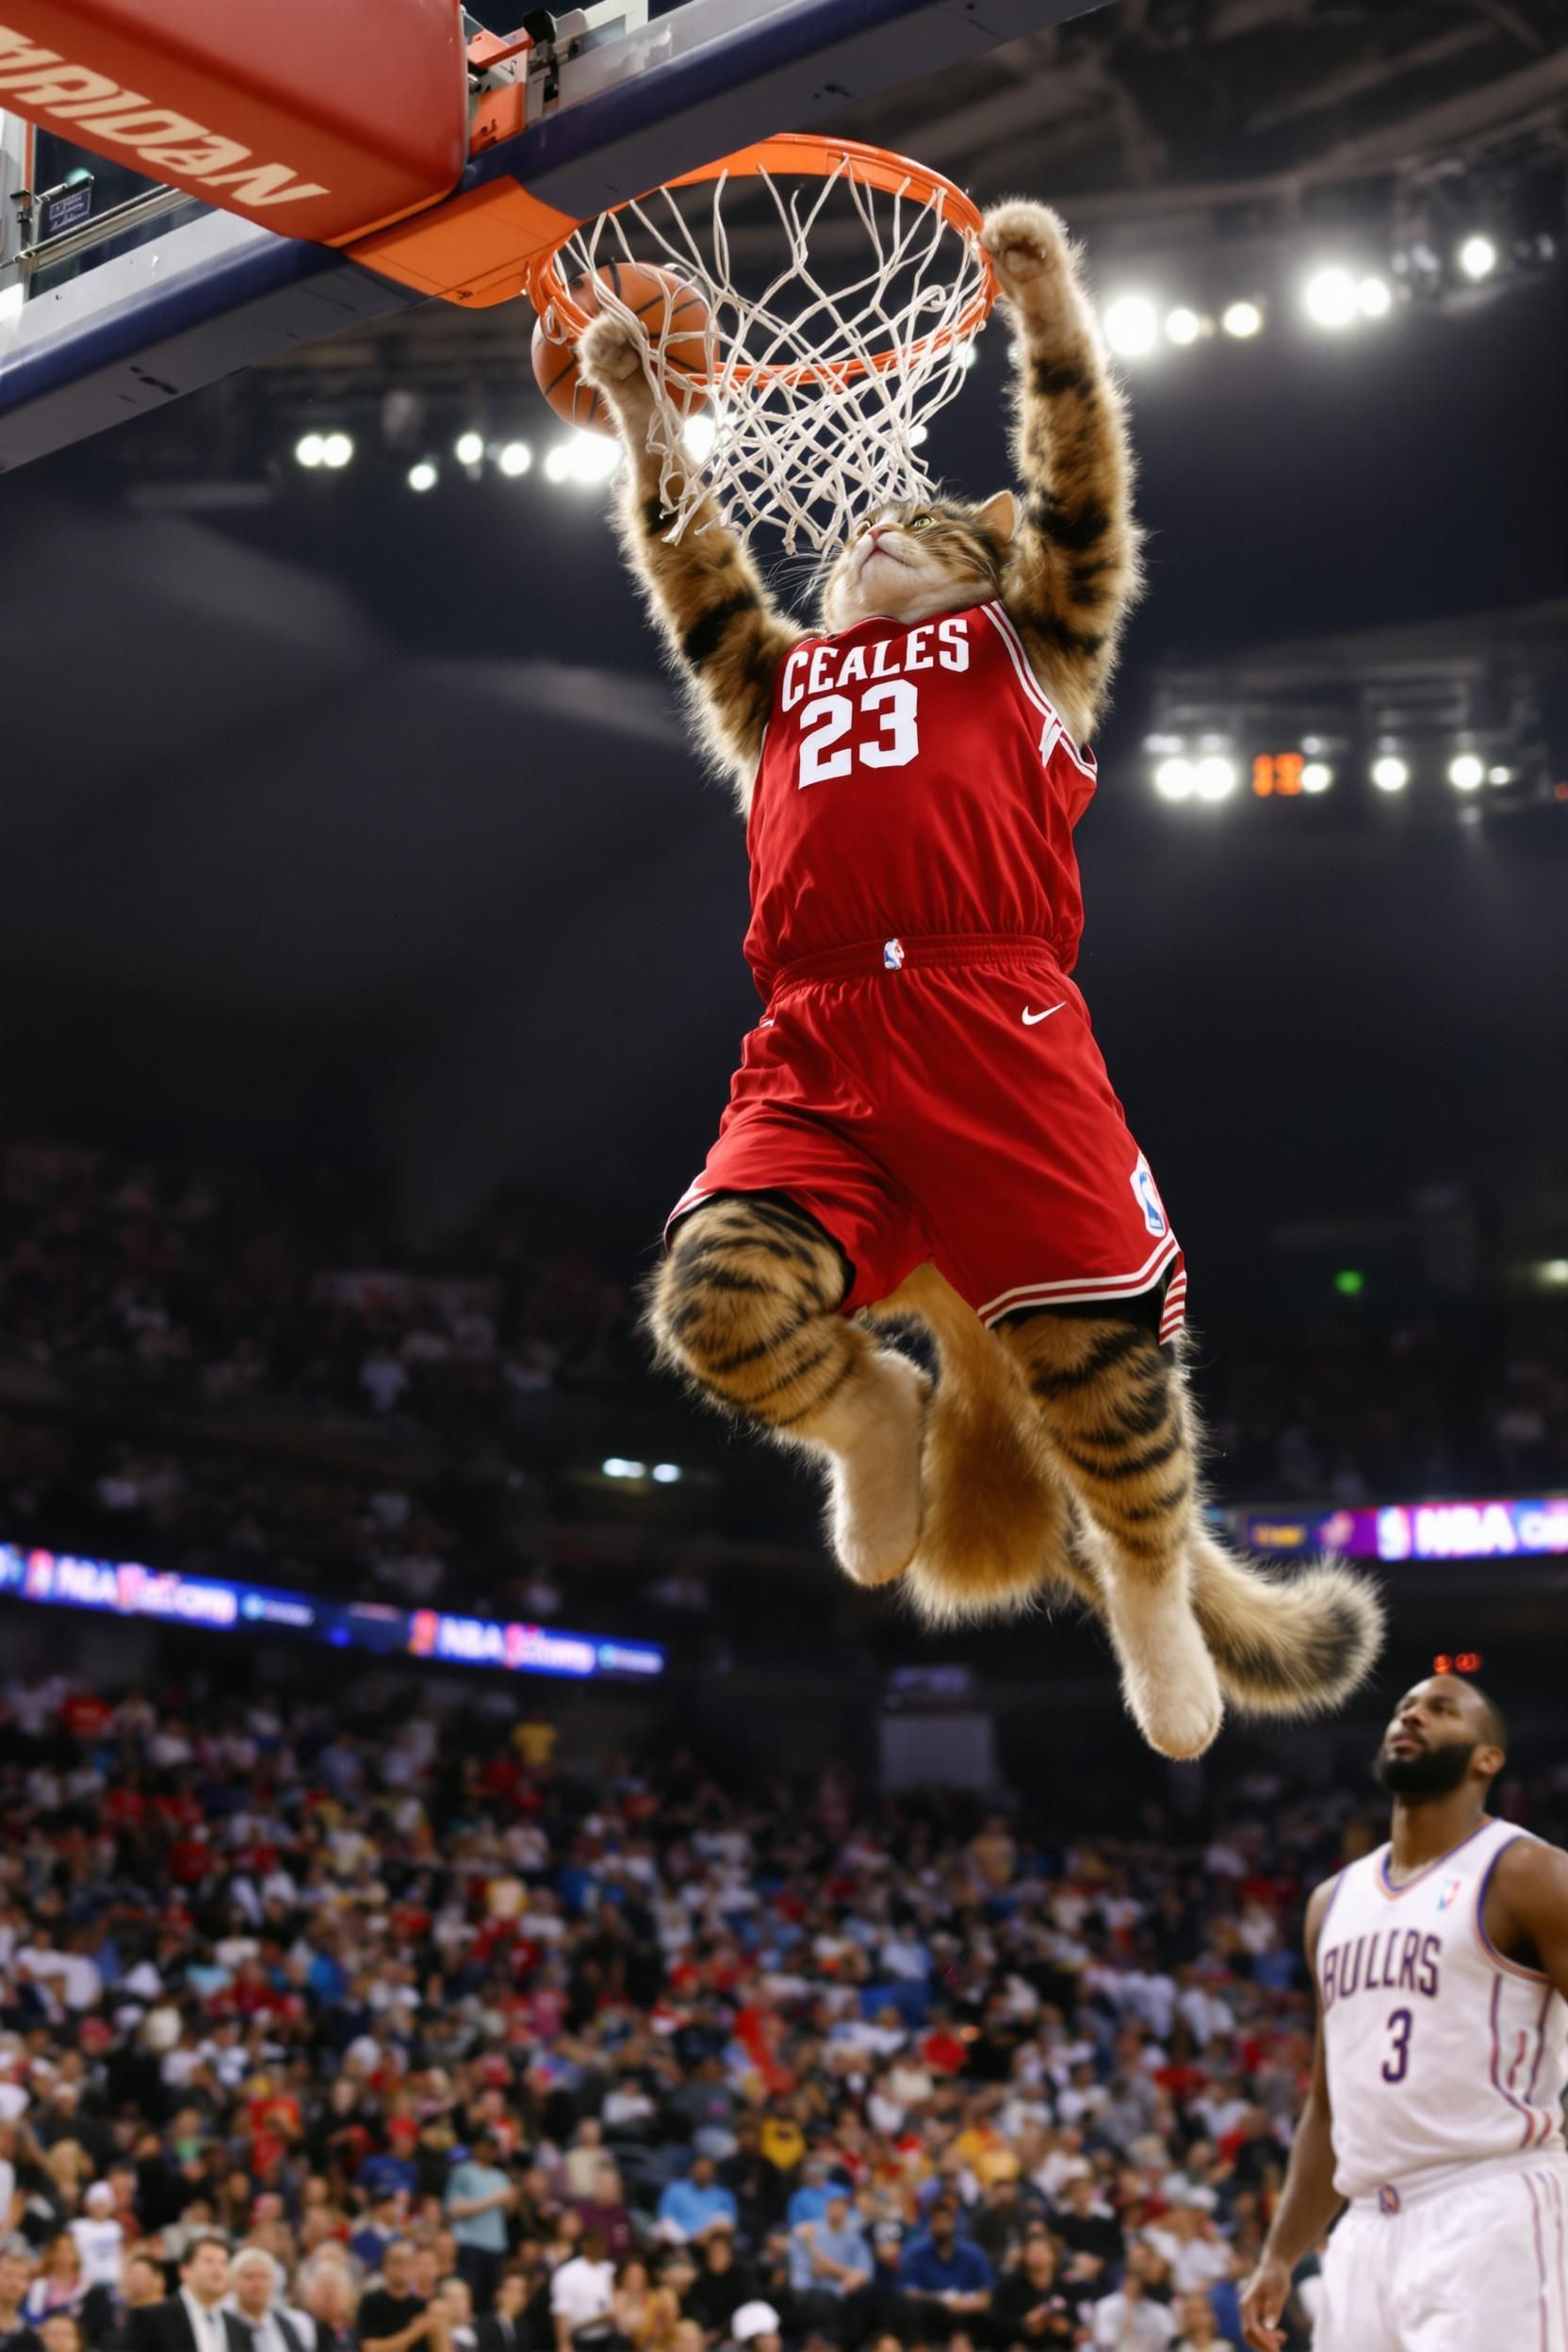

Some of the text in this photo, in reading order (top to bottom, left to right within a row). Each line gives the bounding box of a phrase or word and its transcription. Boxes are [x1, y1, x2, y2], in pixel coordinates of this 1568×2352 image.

[782, 618, 970, 712] CEALES
[798, 678, 920, 790] 23
[1381, 2007, 1413, 2083] 3
